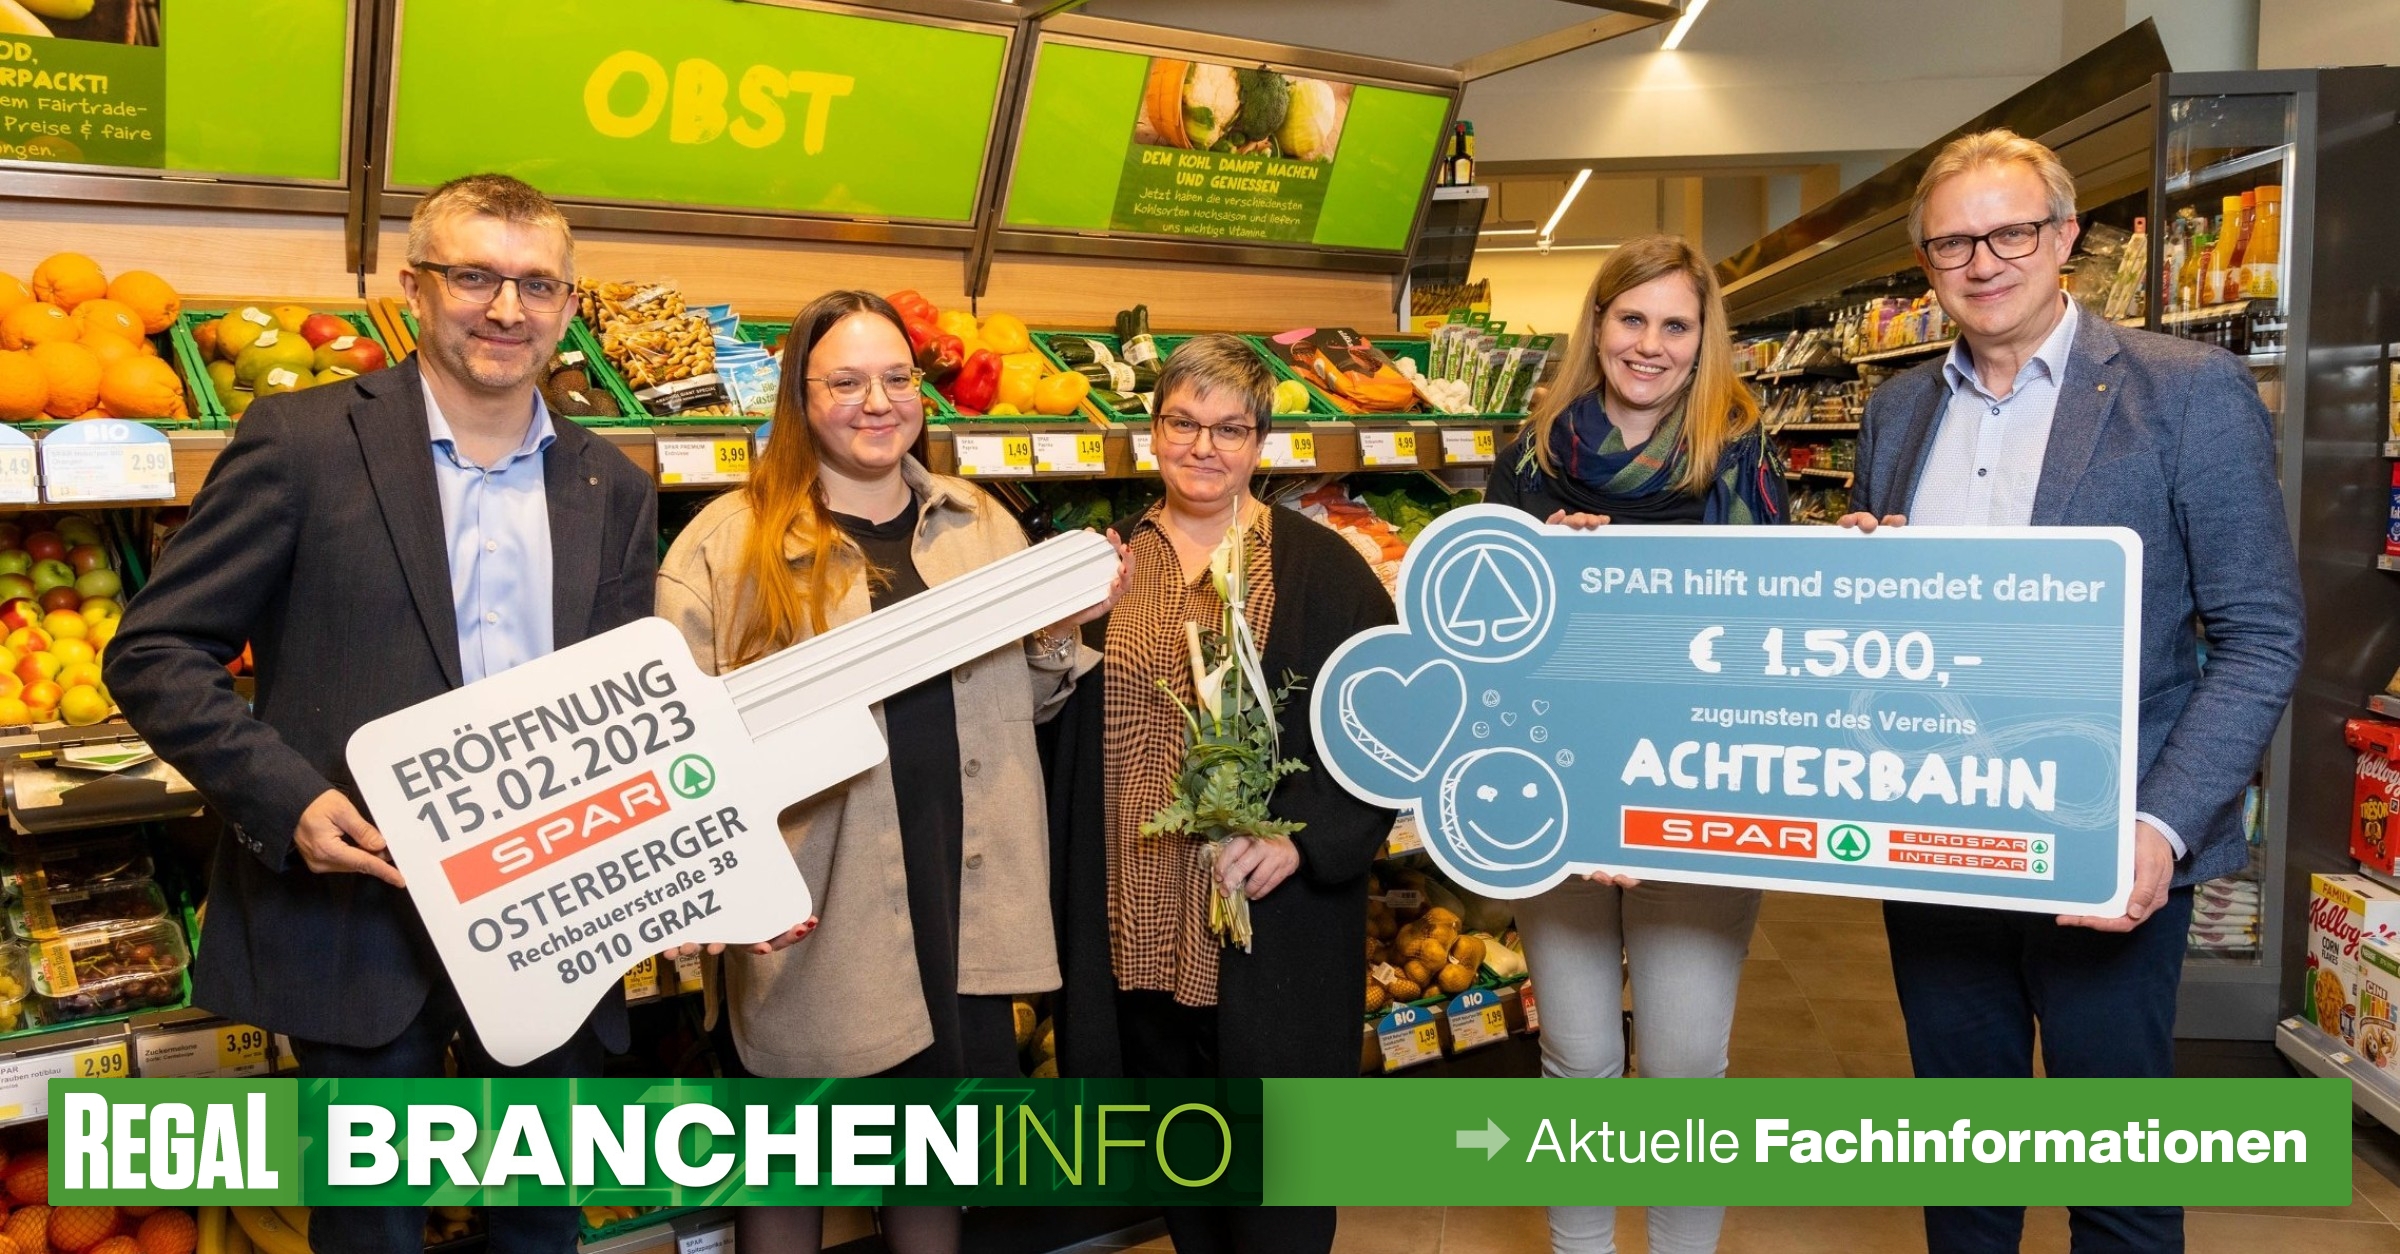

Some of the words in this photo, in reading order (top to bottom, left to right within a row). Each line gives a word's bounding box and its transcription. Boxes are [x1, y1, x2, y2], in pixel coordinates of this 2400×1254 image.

[38, 98, 148, 117] Fairtrade-
[583, 50, 855, 156] OBST
[4, 115, 72, 136] Preise
[80, 120, 93, 141] &
[101, 124, 152, 140] faire
[0, 144, 56, 160] ngen.
[1142, 150, 1172, 167] DEM
[1178, 154, 1211, 170] KOHL
[1219, 158, 1263, 174] DAMPF
[1266, 163, 1319, 180] MACHEN
[1176, 171, 1204, 187] UND
[1210, 175, 1280, 193] GENIESSEN
[1139, 188, 1171, 200] Jetzt
[1174, 189, 1203, 203] haben
[1206, 193, 1221, 204] die
[1224, 195, 1303, 210] verschiedensten
[1133, 203, 1190, 217] Kohlsorten
[1193, 209, 1247, 222] Hochsaison
[1250, 212, 1266, 223] und
[1270, 214, 1301, 225] liefern
[1162, 223, 1180, 233] uns
[1184, 223, 1225, 238] wichtige
[84, 424, 130, 441] BIO
[1478, 435, 1492, 448] 1,49
[1009, 443, 1028, 456] 1,49
[1082, 440, 1101, 454] 1,49
[1295, 438, 1312, 452] 0,99
[1398, 437, 1414, 450] 4,99
[131, 454, 166, 472] 2,99
[720, 447, 745, 463] 3,99
[1581, 567, 1673, 595] SPAR
[1685, 569, 1747, 596] hilft
[1758, 570, 1822, 598] und
[1834, 571, 1982, 604] spendet
[1993, 573, 2105, 603] daher
[1688, 626, 1725, 674] €
[1762, 627, 1983, 689] 1.500,-
[391, 659, 677, 801] ERÖFFNUNG
[1691, 706, 1818, 730] zugunsten
[1826, 708, 1871, 730] des
[1878, 711, 1977, 736] Vereins
[416, 700, 696, 843] 15.02.2023
[1621, 738, 2057, 811] ACHTERBAHN
[2360, 802, 2389, 820] TRESOR
[491, 781, 662, 874] SPAR
[1662, 818, 1813, 852] SPAR
[1903, 833, 2027, 850] EUROSPAR
[1900, 851, 2025, 870] INTERSPAR
[468, 806, 748, 953] OSTERBERGER
[2322, 883, 2350, 904] FAMILY
[507, 864, 706, 972] Rechbauerstraße
[709, 850, 739, 880] 38
[557, 932, 632, 985] 8010
[639, 889, 722, 945] GRAZ
[2309, 898, 2360, 961] Kellog
[2322, 936, 2340, 955] CORN
[2321, 951, 2339, 966] FLAKES
[2366, 981, 2386, 999] CINI
[1462, 992, 1483, 1008] BIO
[1394, 1009, 1416, 1026] BIO
[1487, 1010, 1502, 1025] 1,99
[226, 1030, 263, 1054] 3,99
[1419, 1028, 1435, 1043] 1,99
[145, 1042, 198, 1057] Zuckermelone
[84, 1053, 123, 1078] 2,99
[686, 1239, 703, 1248] SPAR
